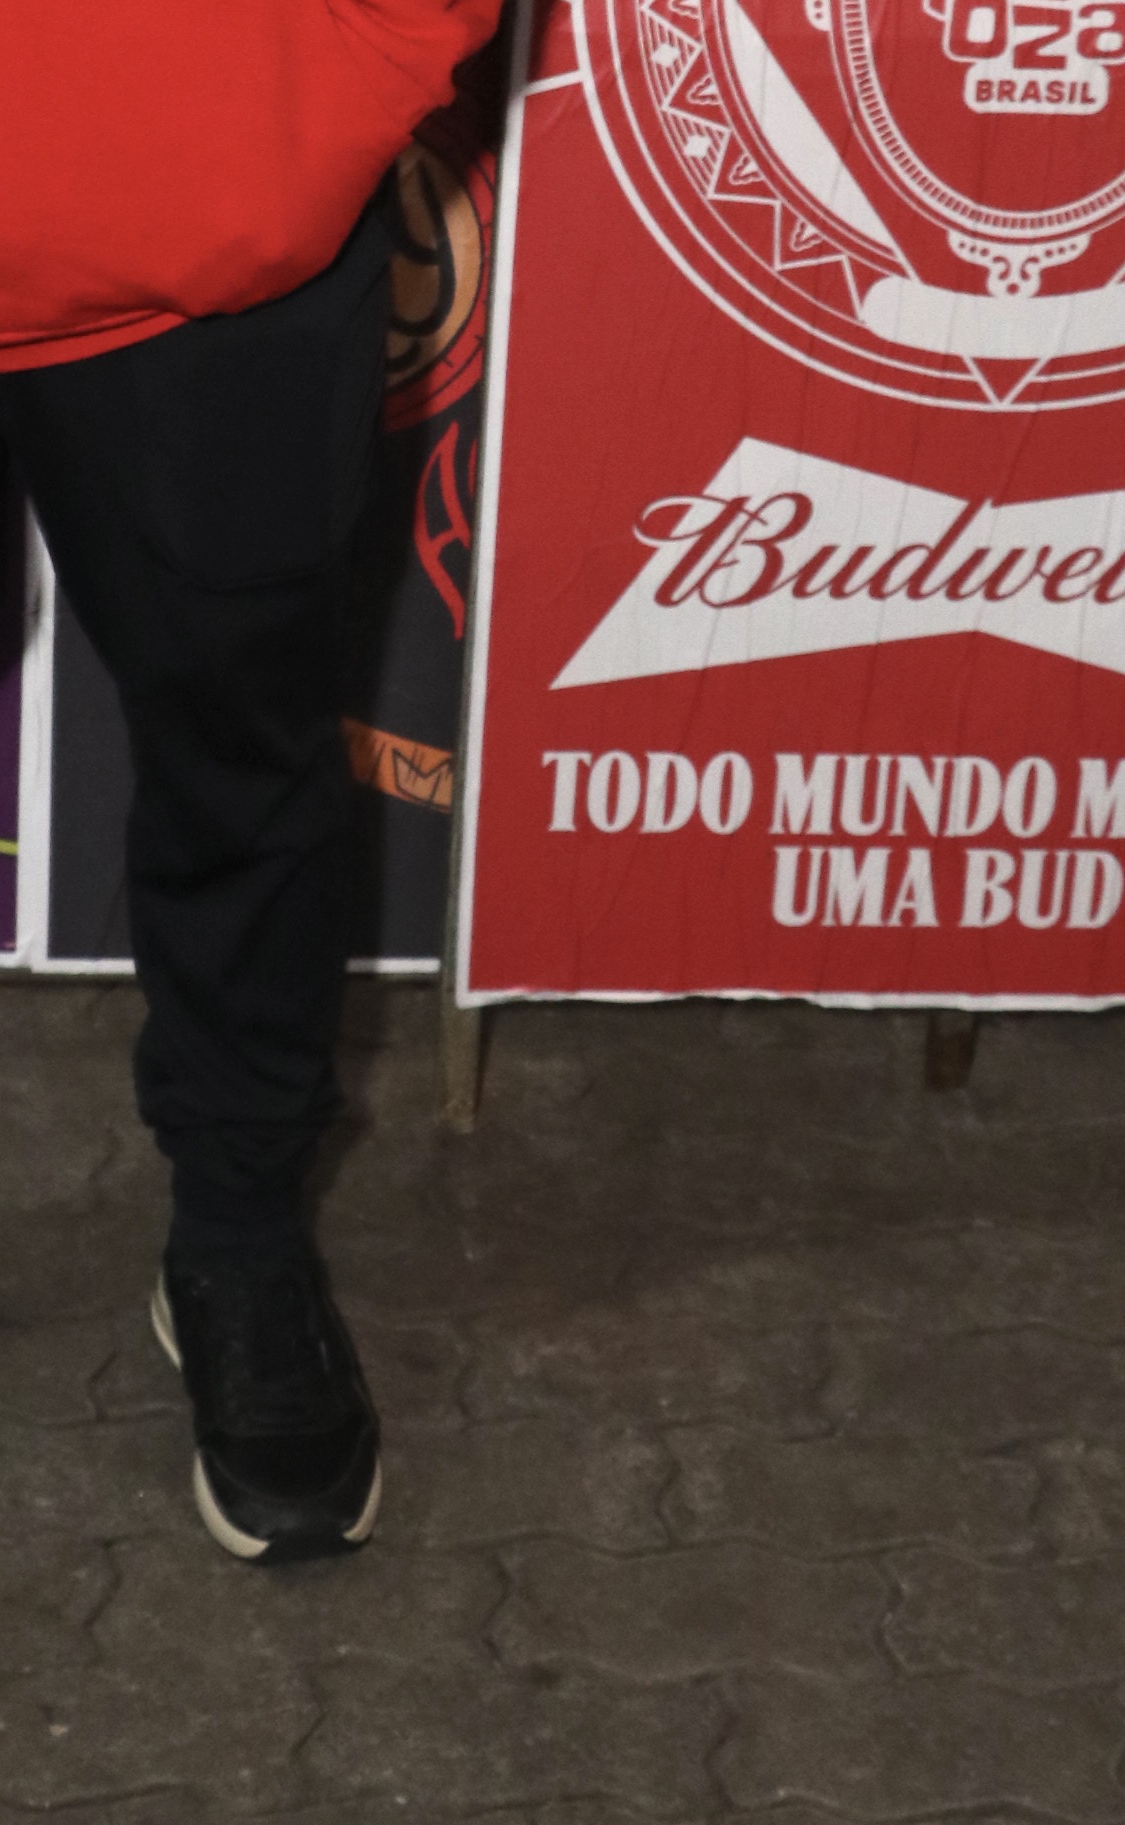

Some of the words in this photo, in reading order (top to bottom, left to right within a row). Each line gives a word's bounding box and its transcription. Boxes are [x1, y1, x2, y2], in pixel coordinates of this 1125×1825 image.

[975, 79, 1096, 105] BRASIL
[542, 750, 754, 835] TODO
[769, 753, 1059, 839] MUNDO
[772, 846, 940, 927] UMA
[959, 847, 1125, 930] BUD
